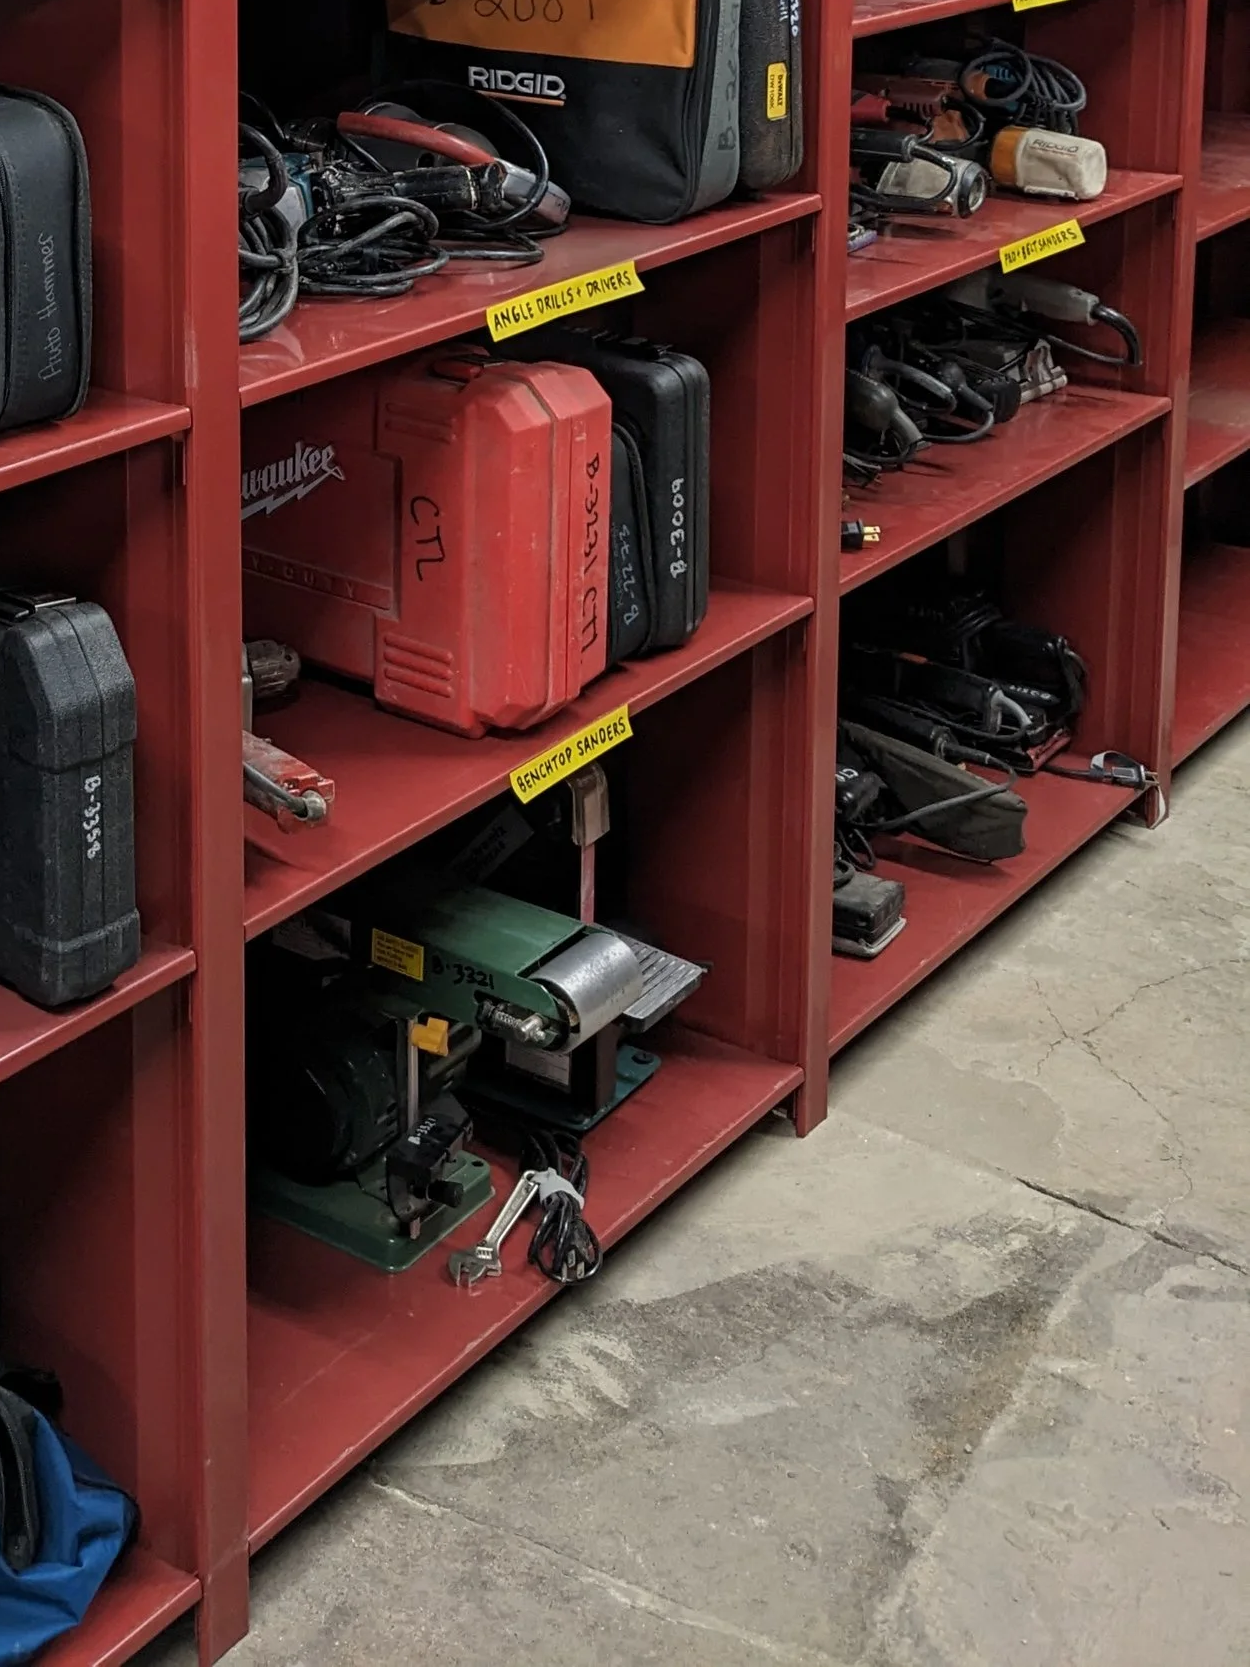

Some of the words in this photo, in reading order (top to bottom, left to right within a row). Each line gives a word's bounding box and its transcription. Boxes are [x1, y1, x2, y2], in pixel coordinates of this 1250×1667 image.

[468, 66, 566, 98] RIDGID
[1032, 139, 1079, 153] RIDGID
[1038, 228, 1078, 251] SANDERS
[493, 301, 534, 332] ANGLE
[536, 287, 574, 314] DRILLS
[586, 270, 632, 298] DRIVERS
[38, 326, 62, 381] Auto
[242, 440, 336, 500] waukee
[584, 453, 600, 573] B-3231
[670, 478, 688, 579] B-3009
[516, 746, 572, 793] BENCHTOP
[576, 716, 626, 756] SANDERS
[83, 775, 101, 859] B-3358
